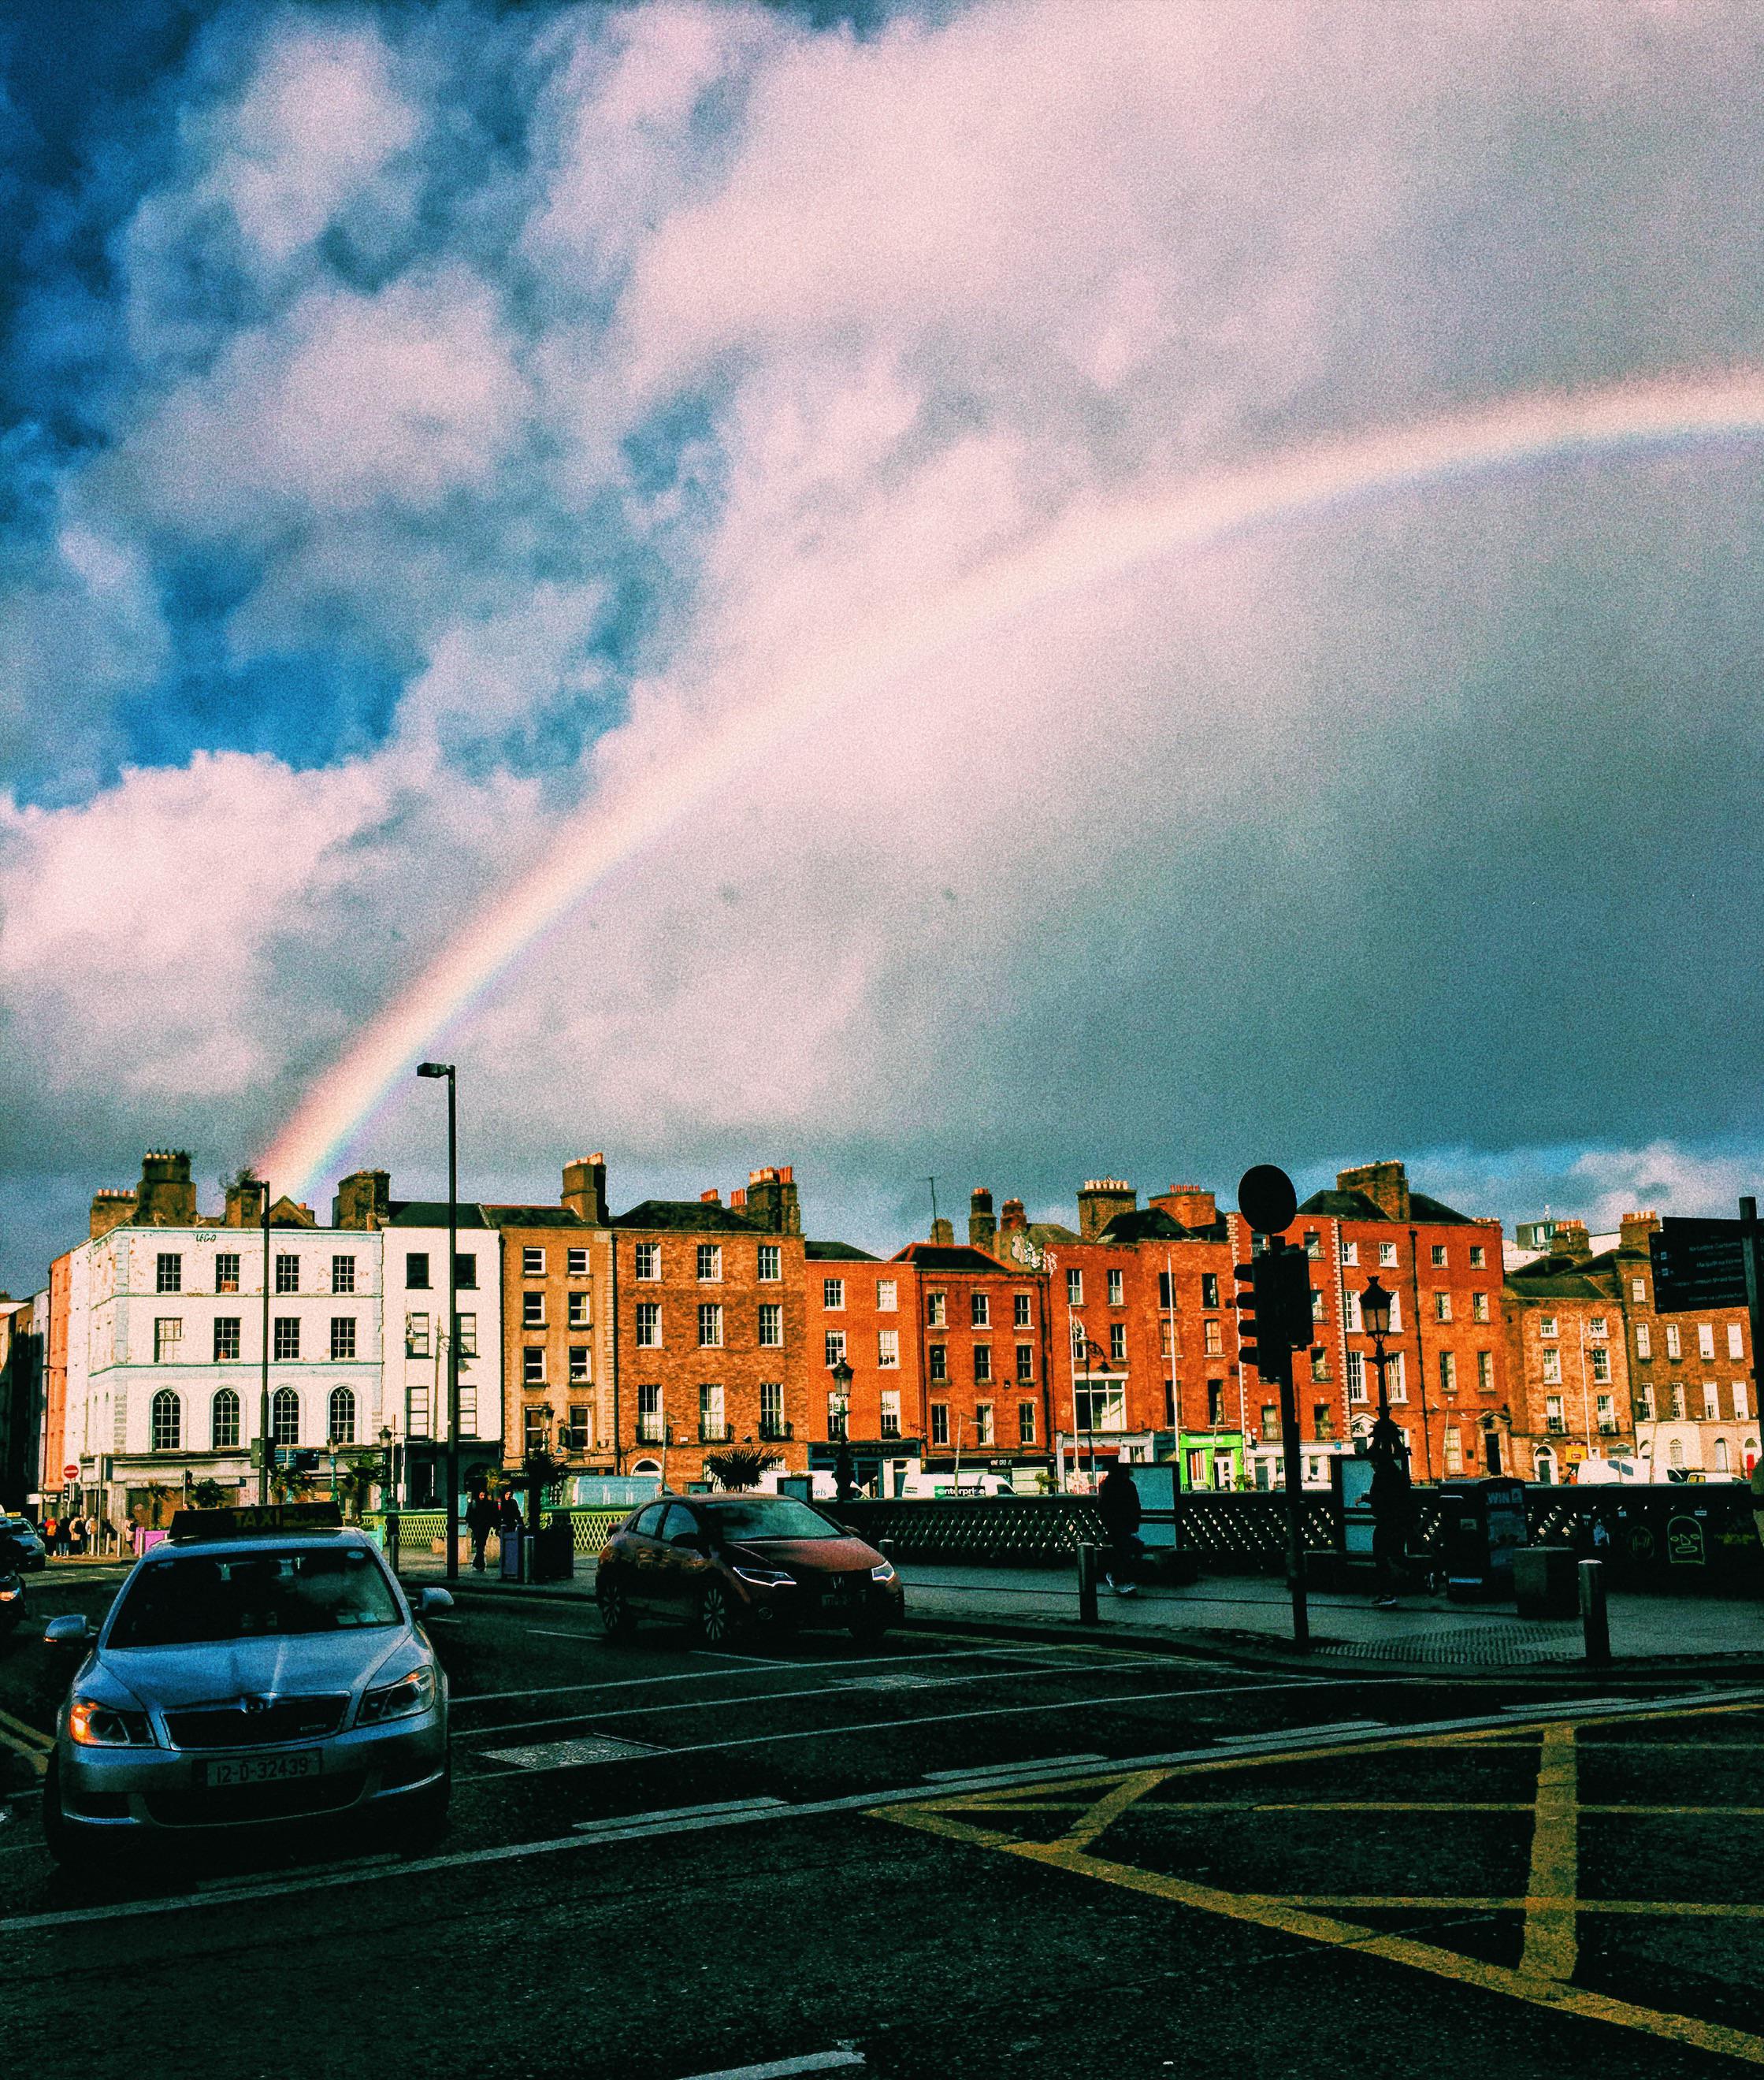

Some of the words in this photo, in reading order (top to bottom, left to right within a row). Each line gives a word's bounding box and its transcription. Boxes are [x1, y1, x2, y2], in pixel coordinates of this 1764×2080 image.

[196, 1233, 217, 1242] LEGO
[1487, 1491, 1510, 1505] WIN
[232, 1508, 281, 1528] TAXI
